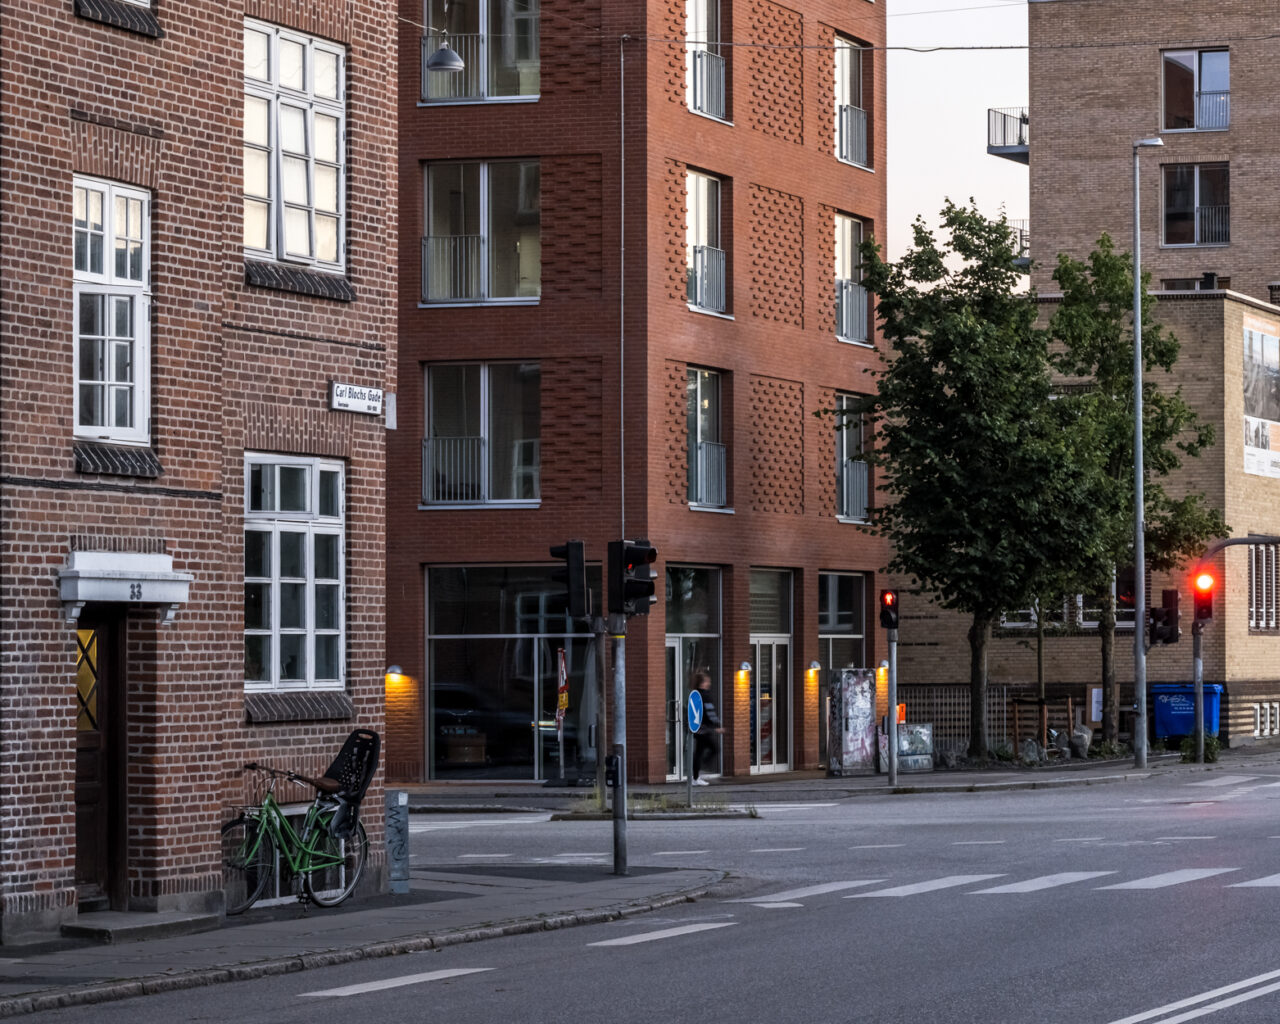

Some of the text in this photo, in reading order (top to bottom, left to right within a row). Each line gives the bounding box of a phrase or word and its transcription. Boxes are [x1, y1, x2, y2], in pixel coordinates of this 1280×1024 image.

[336, 385, 381, 402] Carl Blochs Gade
[130, 583, 142, 600] 33
